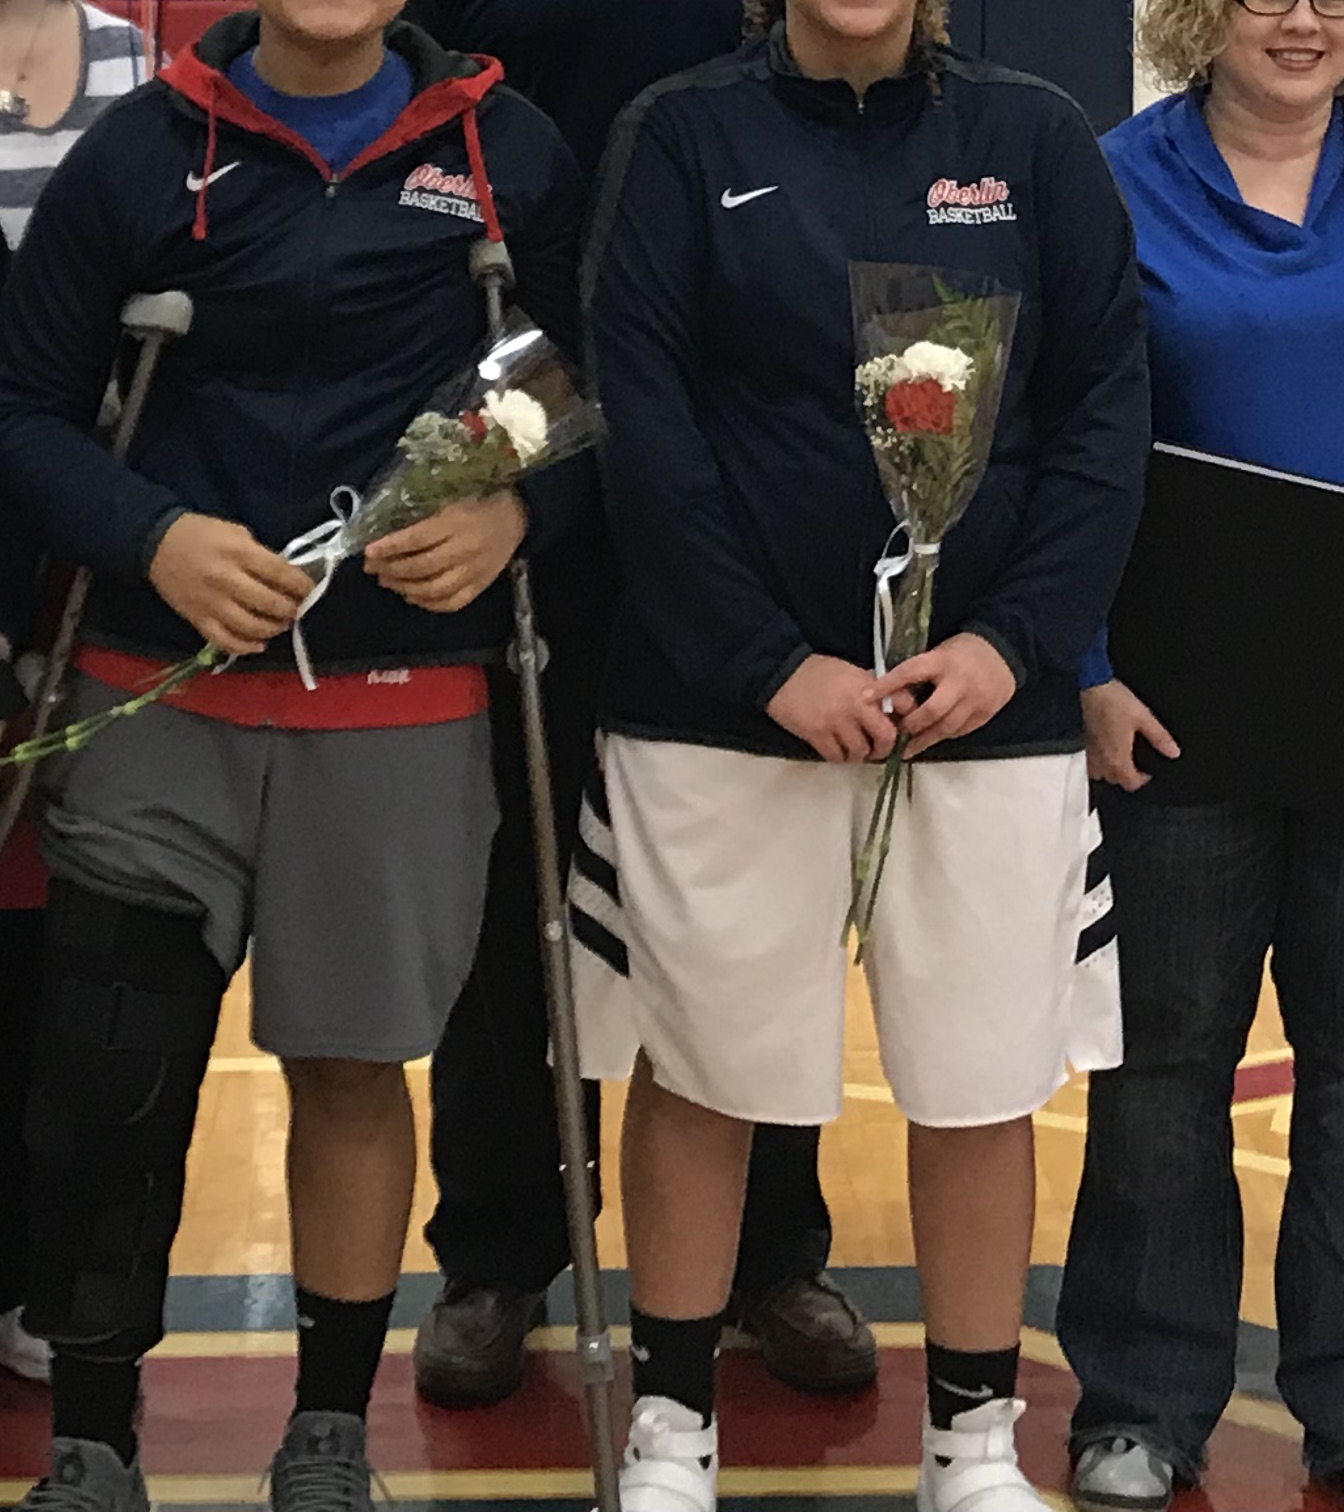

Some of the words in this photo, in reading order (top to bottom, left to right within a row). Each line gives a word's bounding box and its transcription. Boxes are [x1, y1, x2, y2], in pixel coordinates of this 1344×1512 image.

[398, 190, 485, 223] BASKETBAL
[927, 176, 1010, 207] Oberlin
[925, 202, 1017, 225] BASKETBALL
